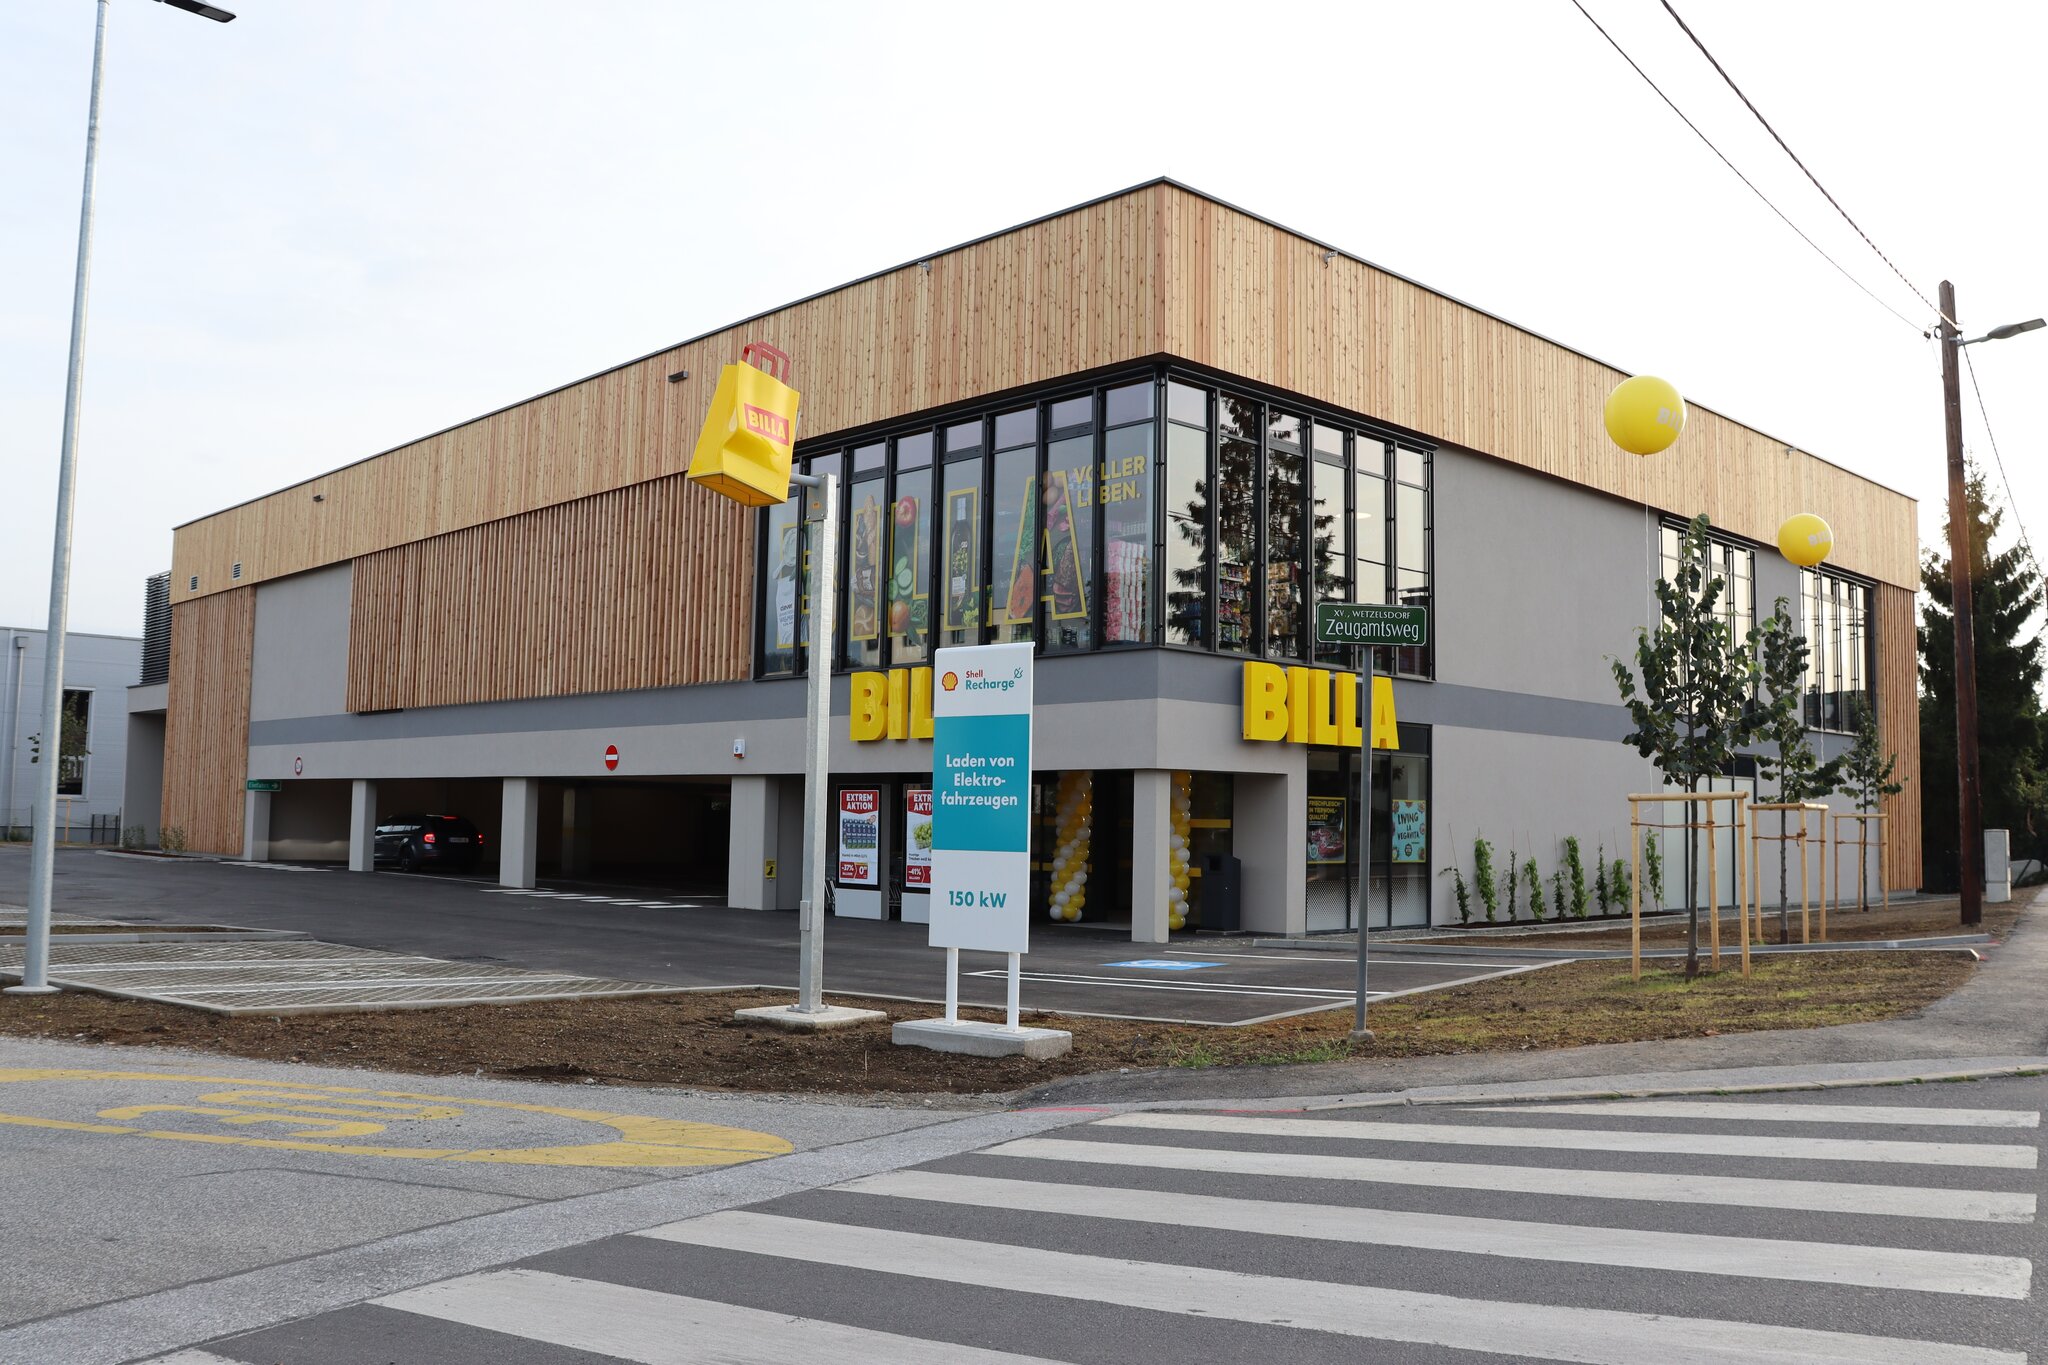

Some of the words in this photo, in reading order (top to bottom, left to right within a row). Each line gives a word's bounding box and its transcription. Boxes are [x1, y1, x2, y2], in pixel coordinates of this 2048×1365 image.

[747, 409, 787, 440] BILLA
[1352, 610, 1411, 620] WETZELSDORF
[1325, 618, 1419, 642] Zeugamtsweg
[965, 670, 984, 679] Shell
[965, 678, 1015, 692] Recharge
[850, 667, 934, 741] BIL
[1243, 661, 1400, 750] BILLA
[945, 753, 986, 768] Laden
[989, 757, 1015, 767] von
[953, 772, 1006, 787] Elektro-
[846, 793, 873, 802] EXTREM
[913, 793, 932, 802] EXTR
[941, 790, 1018, 810] fahrzeugen
[846, 801, 873, 810] AKTION
[913, 802, 932, 811] AKTI
[949, 890, 974, 907] 150
[979, 890, 1007, 908] kW
